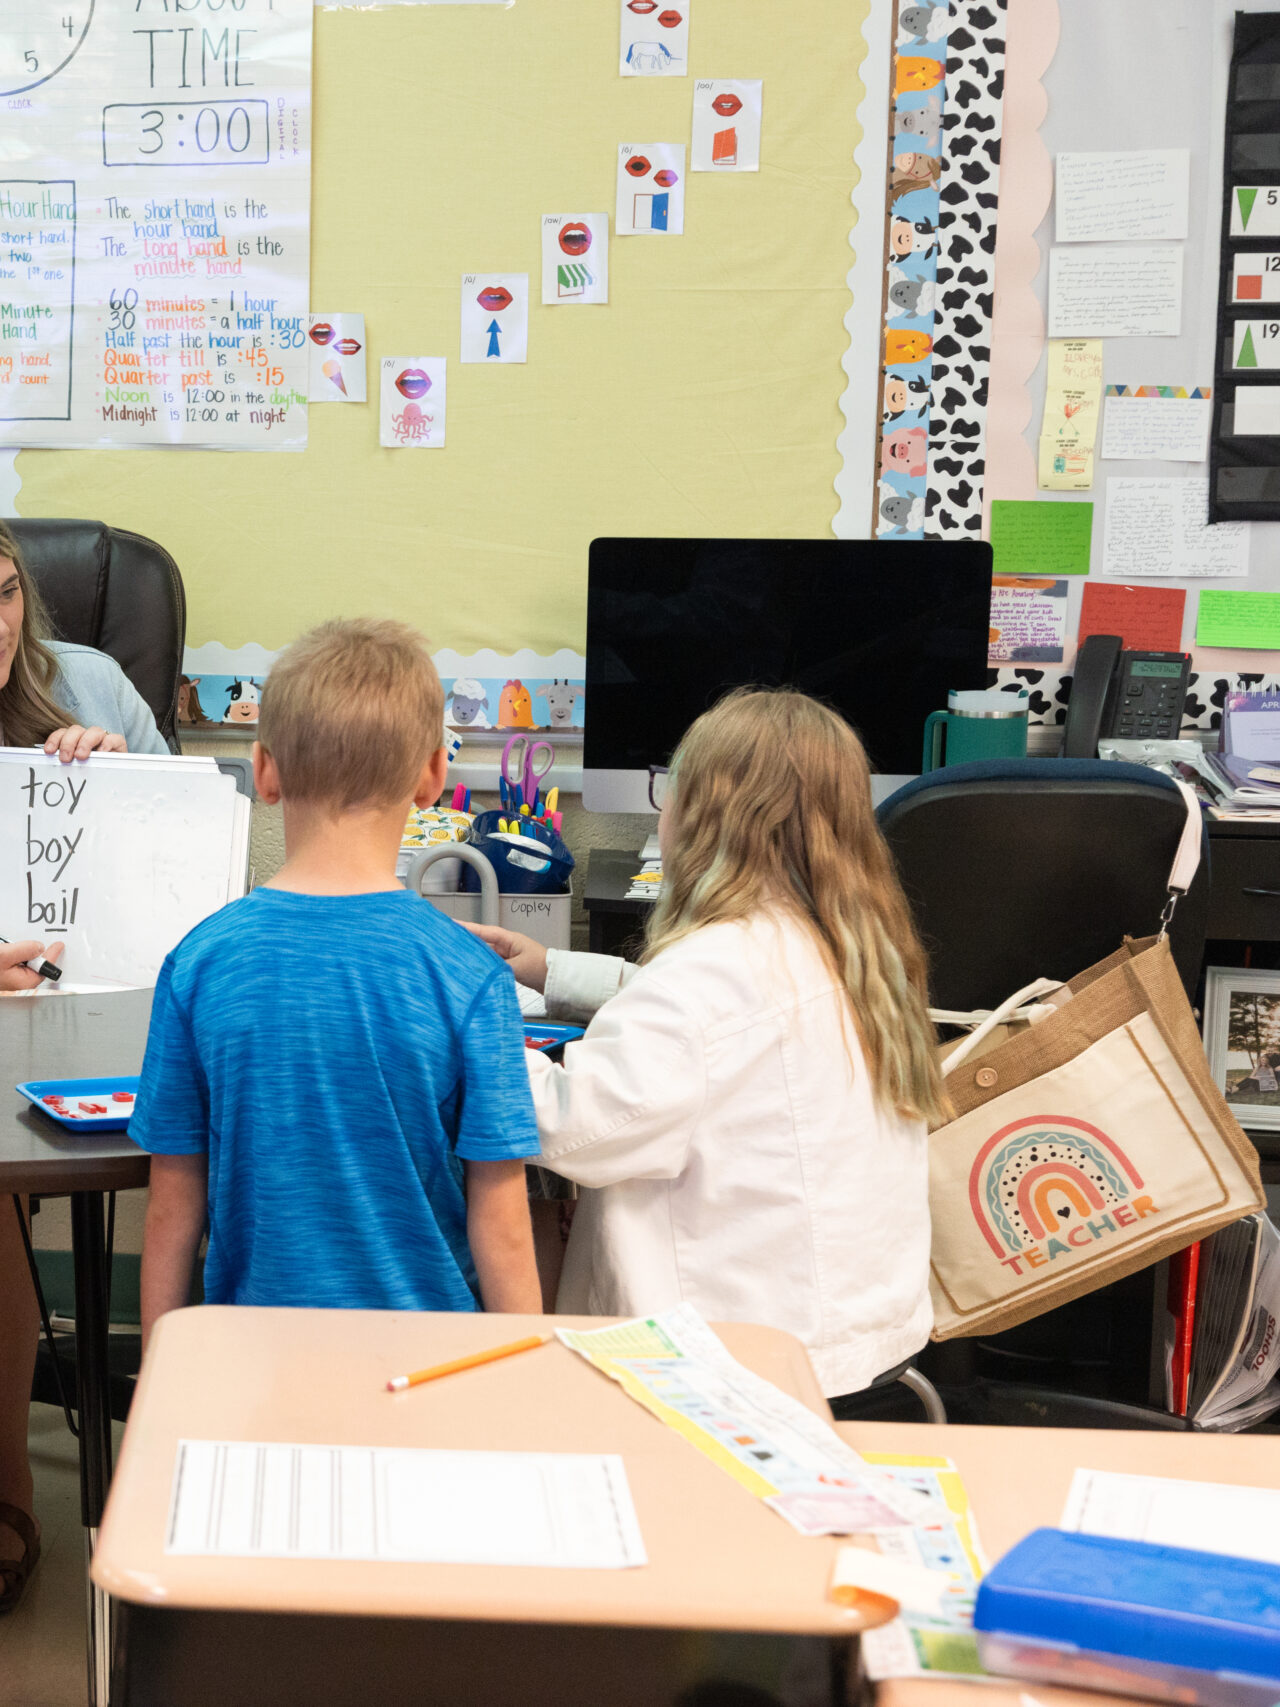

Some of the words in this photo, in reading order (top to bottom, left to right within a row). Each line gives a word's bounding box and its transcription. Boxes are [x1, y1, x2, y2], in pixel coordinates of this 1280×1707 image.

[62, 16, 74, 38] 4
[24, 50, 39, 73] 5
[133, 27, 258, 88] TIME
[138, 107, 251, 154] 3:00
[0, 190, 39, 219] Hour
[41, 189, 76, 220] Hand
[105, 196, 131, 219] The
[144, 198, 180, 220] short
[185, 197, 216, 219] hand
[224, 204, 237, 218] is
[244, 198, 269, 219] the
[1267, 190, 1278, 205] 5
[1, 231, 34, 245] short
[133, 220, 173, 239] hour
[182, 218, 220, 238] hand
[8, 249, 32, 263] two
[100, 236, 127, 257] The
[144, 238, 178, 258] long
[187, 235, 228, 257] hand
[237, 240, 250, 256] is
[257, 236, 284, 257] the
[0, 268, 16, 279] the
[44, 270, 64, 280] one
[133, 259, 196, 276] minute
[206, 257, 242, 275] hand
[1265, 256, 1280, 272] 12
[109, 288, 139, 311] 60
[146, 296, 205, 312] minutes
[244, 290, 278, 312] hour
[1, 303, 53, 320] Minute
[108, 311, 136, 330] 30
[146, 315, 206, 330] minutes
[221, 316, 230, 329] a
[237, 312, 264, 330] half
[270, 312, 305, 330] hour
[2, 322, 37, 340] Hand
[1263, 323, 1280, 339] 19
[105, 331, 136, 348] Half
[143, 332, 172, 354] past
[179, 332, 202, 349] the
[208, 332, 245, 348] hour
[252, 335, 262, 348] is
[104, 349, 170, 368] Quarter
[178, 350, 204, 367] till
[217, 351, 227, 367] is
[19, 373, 50, 385] count
[104, 366, 169, 385] Quarter
[181, 370, 213, 393] past
[224, 370, 236, 384] is
[105, 386, 151, 403] Noon
[163, 390, 174, 403] is
[186, 388, 225, 404] 12:00
[230, 392, 241, 403] in
[246, 391, 265, 404] the
[102, 403, 158, 426] Midnight
[170, 409, 180, 421] is
[186, 408, 218, 422] 12:00
[226, 410, 241, 422] at
[250, 407, 287, 430] night
[21, 767, 87, 814] toy
[26, 814, 84, 882] boy
[26, 871, 79, 924] boil
[510, 900, 552, 917] Copley
[1000, 1195, 1161, 1276] TEACHER
[1252, 1315, 1276, 1372] SCHOOL
